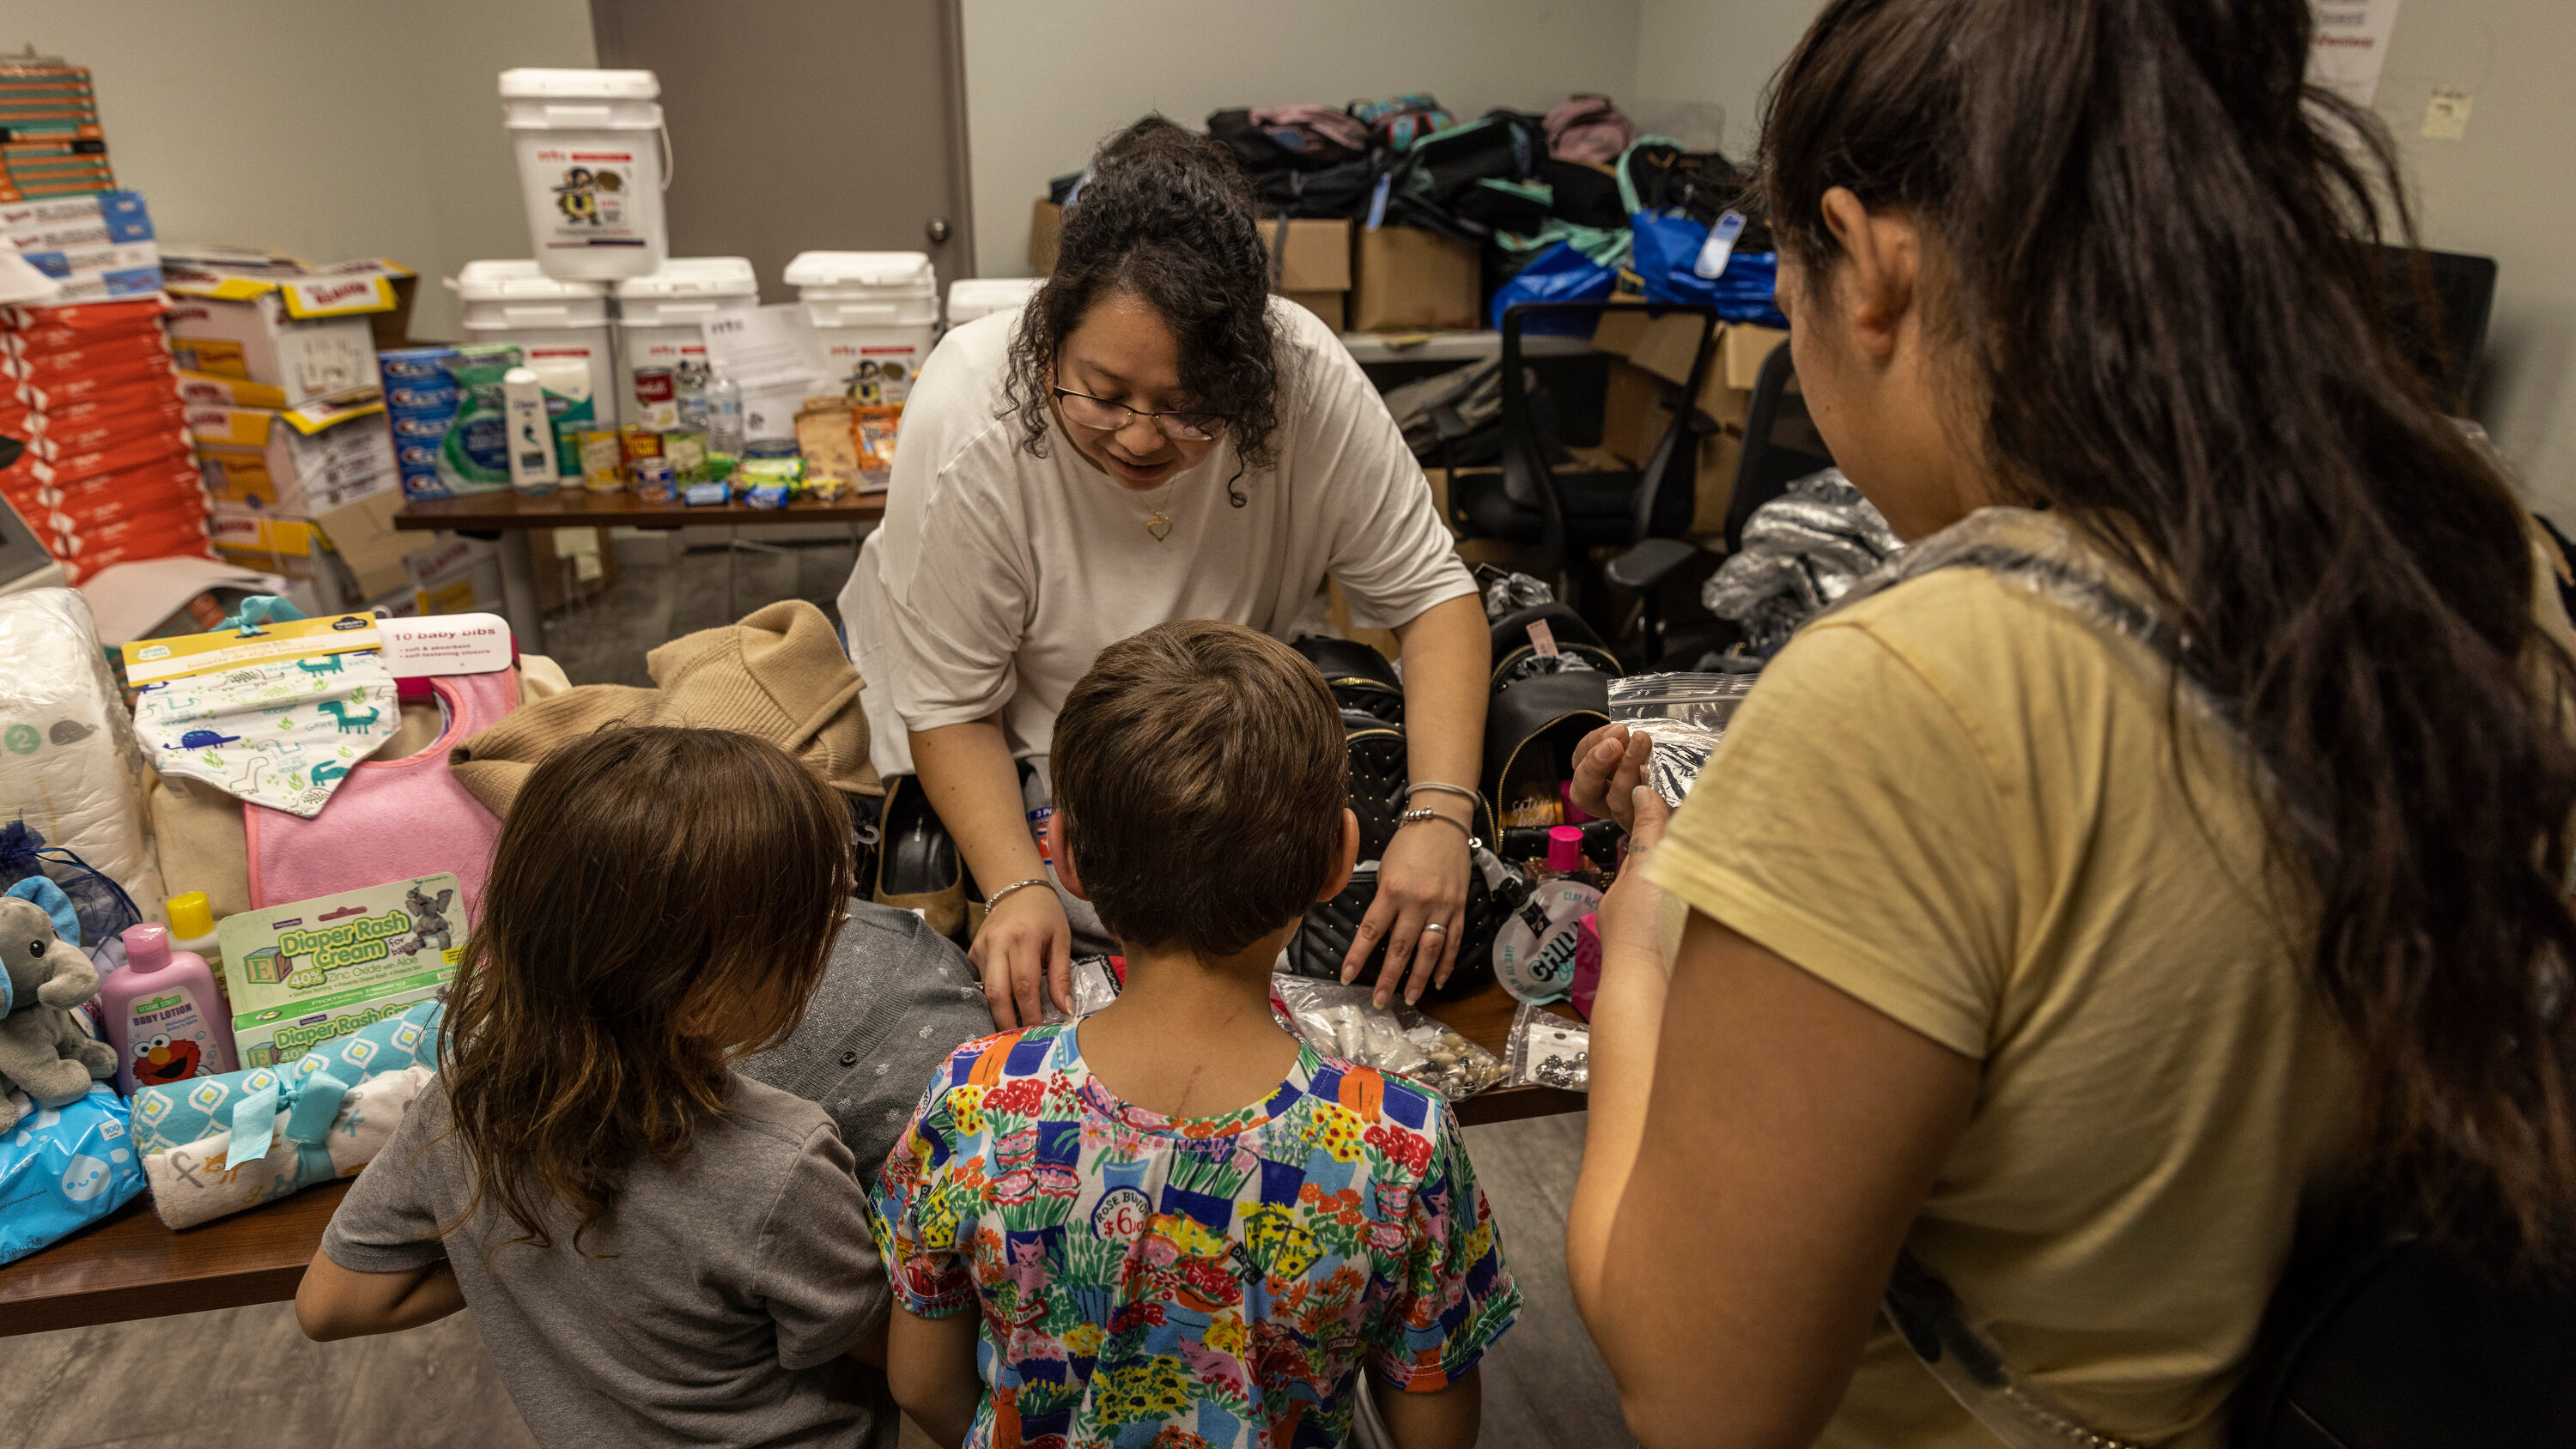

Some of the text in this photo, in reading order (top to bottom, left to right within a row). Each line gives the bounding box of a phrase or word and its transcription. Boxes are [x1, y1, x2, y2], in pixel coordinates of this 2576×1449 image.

[395, 627, 495, 641] 10 baby bibs
[13, 731, 33, 749] 2
[283, 913, 406, 955] Diaper Rash
[315, 937, 406, 967] Cream for
[252, 960, 272, 981] E
[291, 970, 324, 986] 40%
[328, 971, 350, 983] Zinc
[352, 964, 381, 977] Oxide
[398, 956, 419, 967] Aloe
[138, 996, 181, 1013] SESAME STREET
[312, 980, 405, 1005] Promotes Healing
[133, 1003, 192, 1026] BABY LOTION
[276, 1024, 336, 1046] Diaper
[338, 1009, 379, 1031] Rash
[104, 1124, 120, 1134] 100
[1096, 1191, 1150, 1223] ROSE BUNCH
